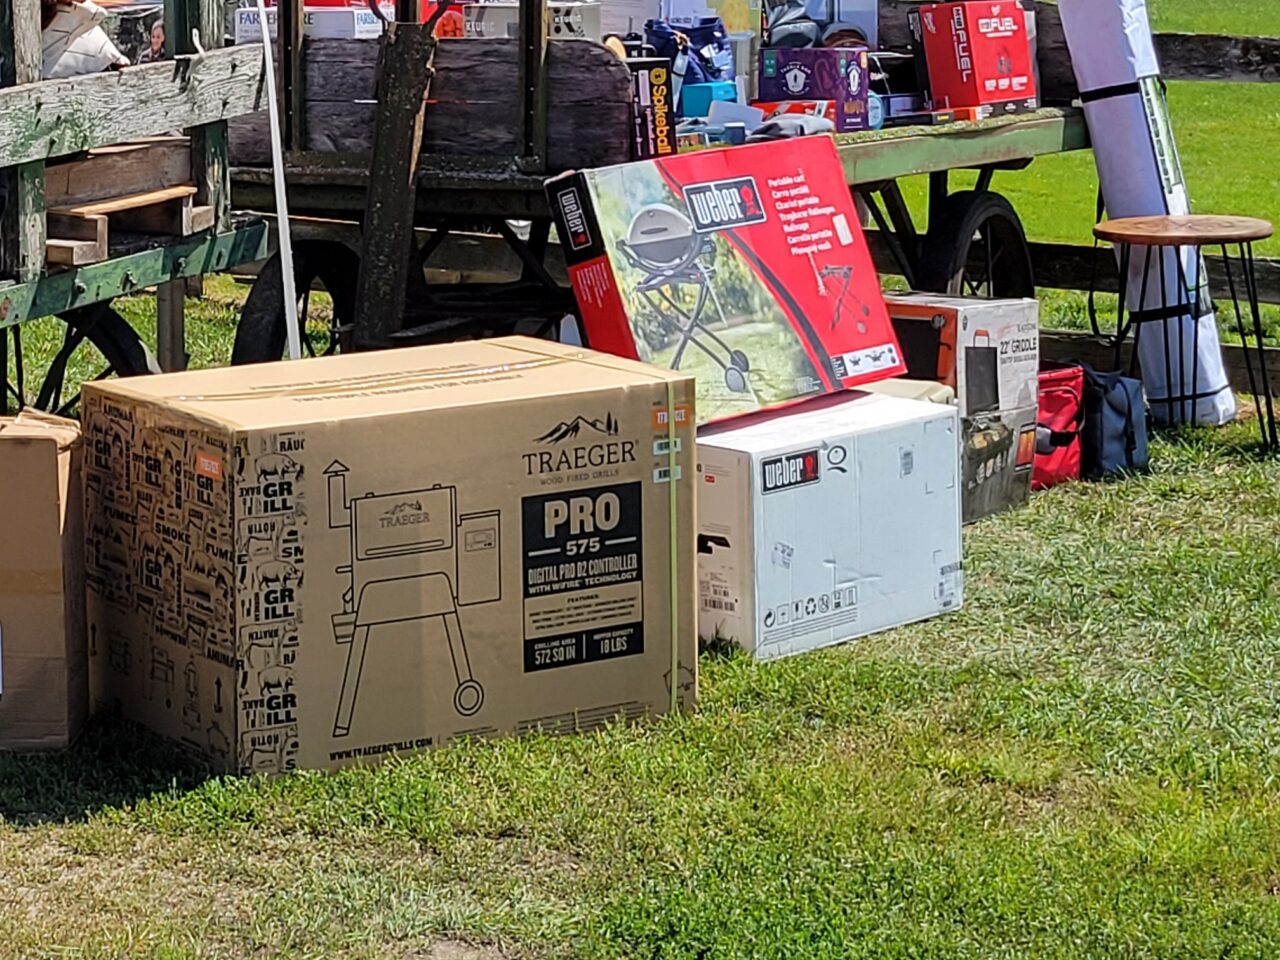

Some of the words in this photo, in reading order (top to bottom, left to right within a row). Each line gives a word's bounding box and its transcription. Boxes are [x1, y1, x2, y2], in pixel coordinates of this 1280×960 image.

[957, 30, 971, 82] FUEL
[652, 85, 671, 154] Spikeball
[562, 192, 585, 234] weber
[690, 184, 744, 224] weber
[522, 441, 636, 475] TRAEGER
[540, 477, 563, 486] WOOD
[567, 473, 589, 482] FIRED
[592, 469, 619, 479] GRILLS
[764, 456, 804, 488] weber
[262, 481, 294, 498] GR
[263, 498, 294, 513] ILL
[544, 491, 620, 539] PRO
[379, 512, 430, 528] TRAEGER
[155, 522, 191, 546] SMOKE
[566, 537, 600, 556] 575
[528, 565, 558, 585] DIGITAL
[560, 562, 575, 580] PRO
[577, 561, 587, 577] D2
[589, 553, 637, 576] CONTROLLER
[528, 584, 551, 594] WITH
[584, 571, 637, 586] TECHNOLOGY
[264, 588, 294, 604] GR
[264, 604, 294, 620] ILL
[611, 636, 627, 652] LBS
[535, 650, 551, 665] 572
[552, 647, 564, 662] SQ
[566, 645, 575, 659] IN
[266, 693, 297, 711] GR
[267, 710, 297, 726] ILL
